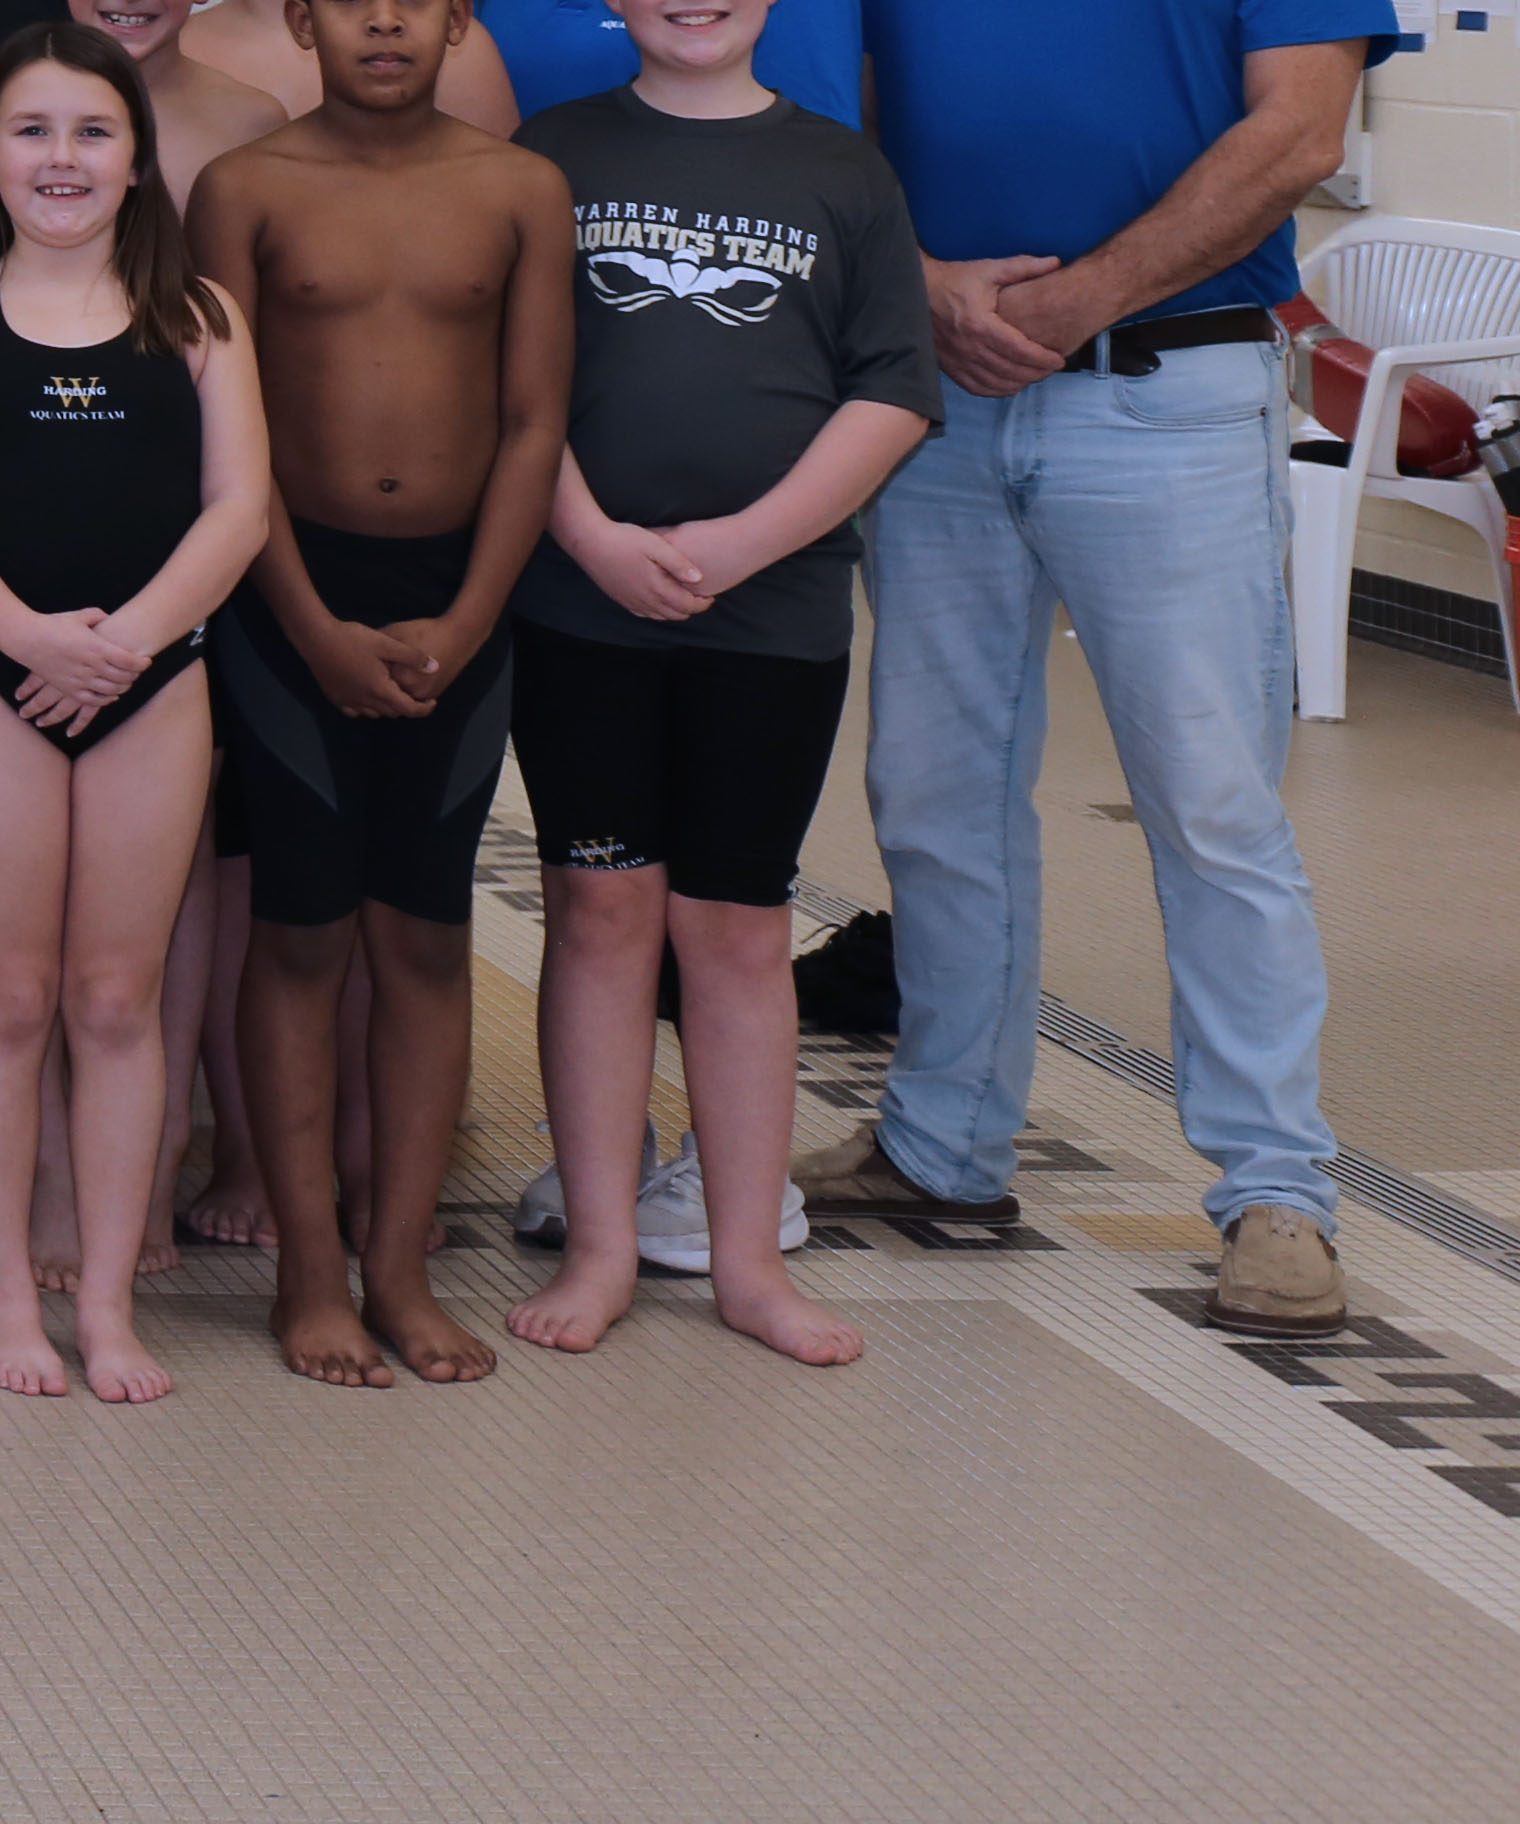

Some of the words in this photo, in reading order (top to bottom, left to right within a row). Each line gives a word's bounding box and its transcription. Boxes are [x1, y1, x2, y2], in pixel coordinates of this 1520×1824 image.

[696, 211, 819, 253] HARDING
[722, 235, 816, 281] TEAM
[43, 384, 107, 398] HARDING
[29, 409, 89, 421] AQUATICS
[90, 410, 125, 420] TEAM
